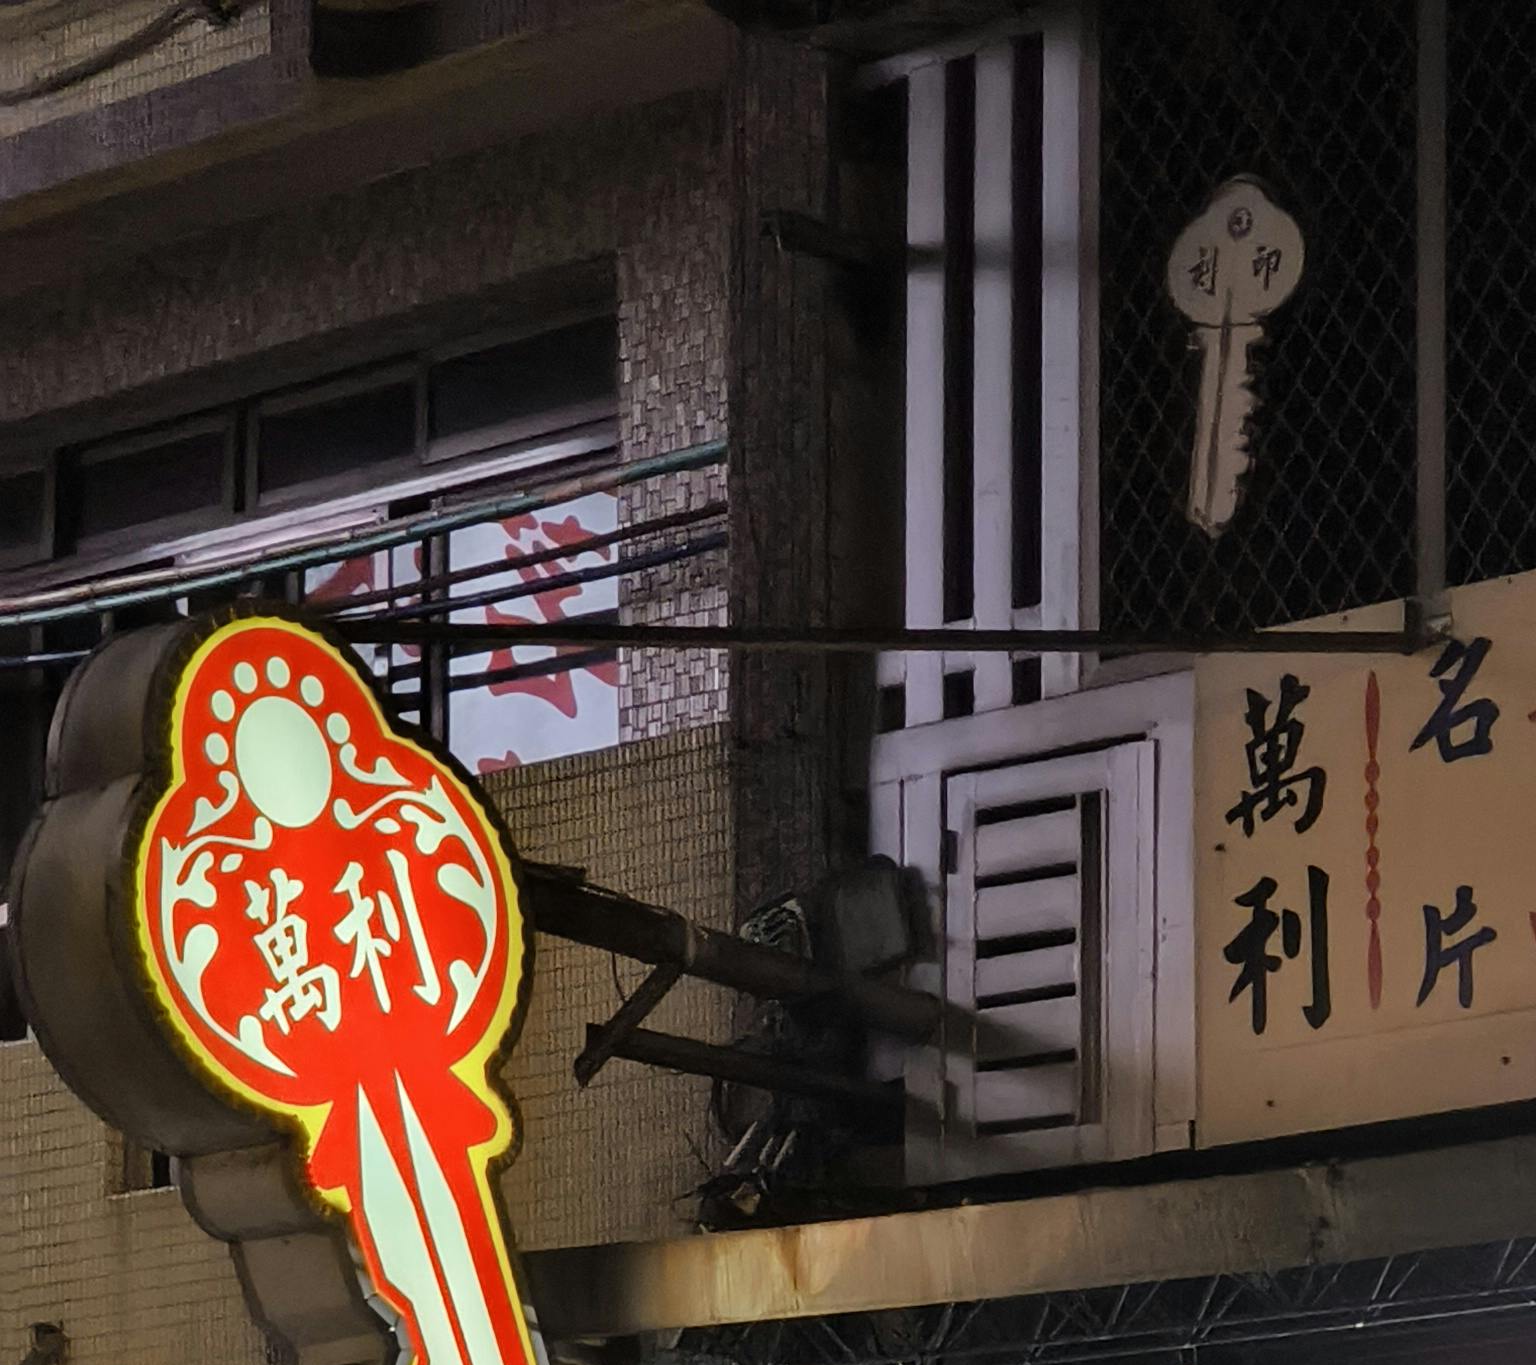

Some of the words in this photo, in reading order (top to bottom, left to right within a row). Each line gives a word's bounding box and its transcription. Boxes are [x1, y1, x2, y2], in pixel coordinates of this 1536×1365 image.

[245, 848, 440, 1034] 萬利
[1222, 673, 1332, 1035] 萬利
[1409, 636, 1500, 1010] 名片
